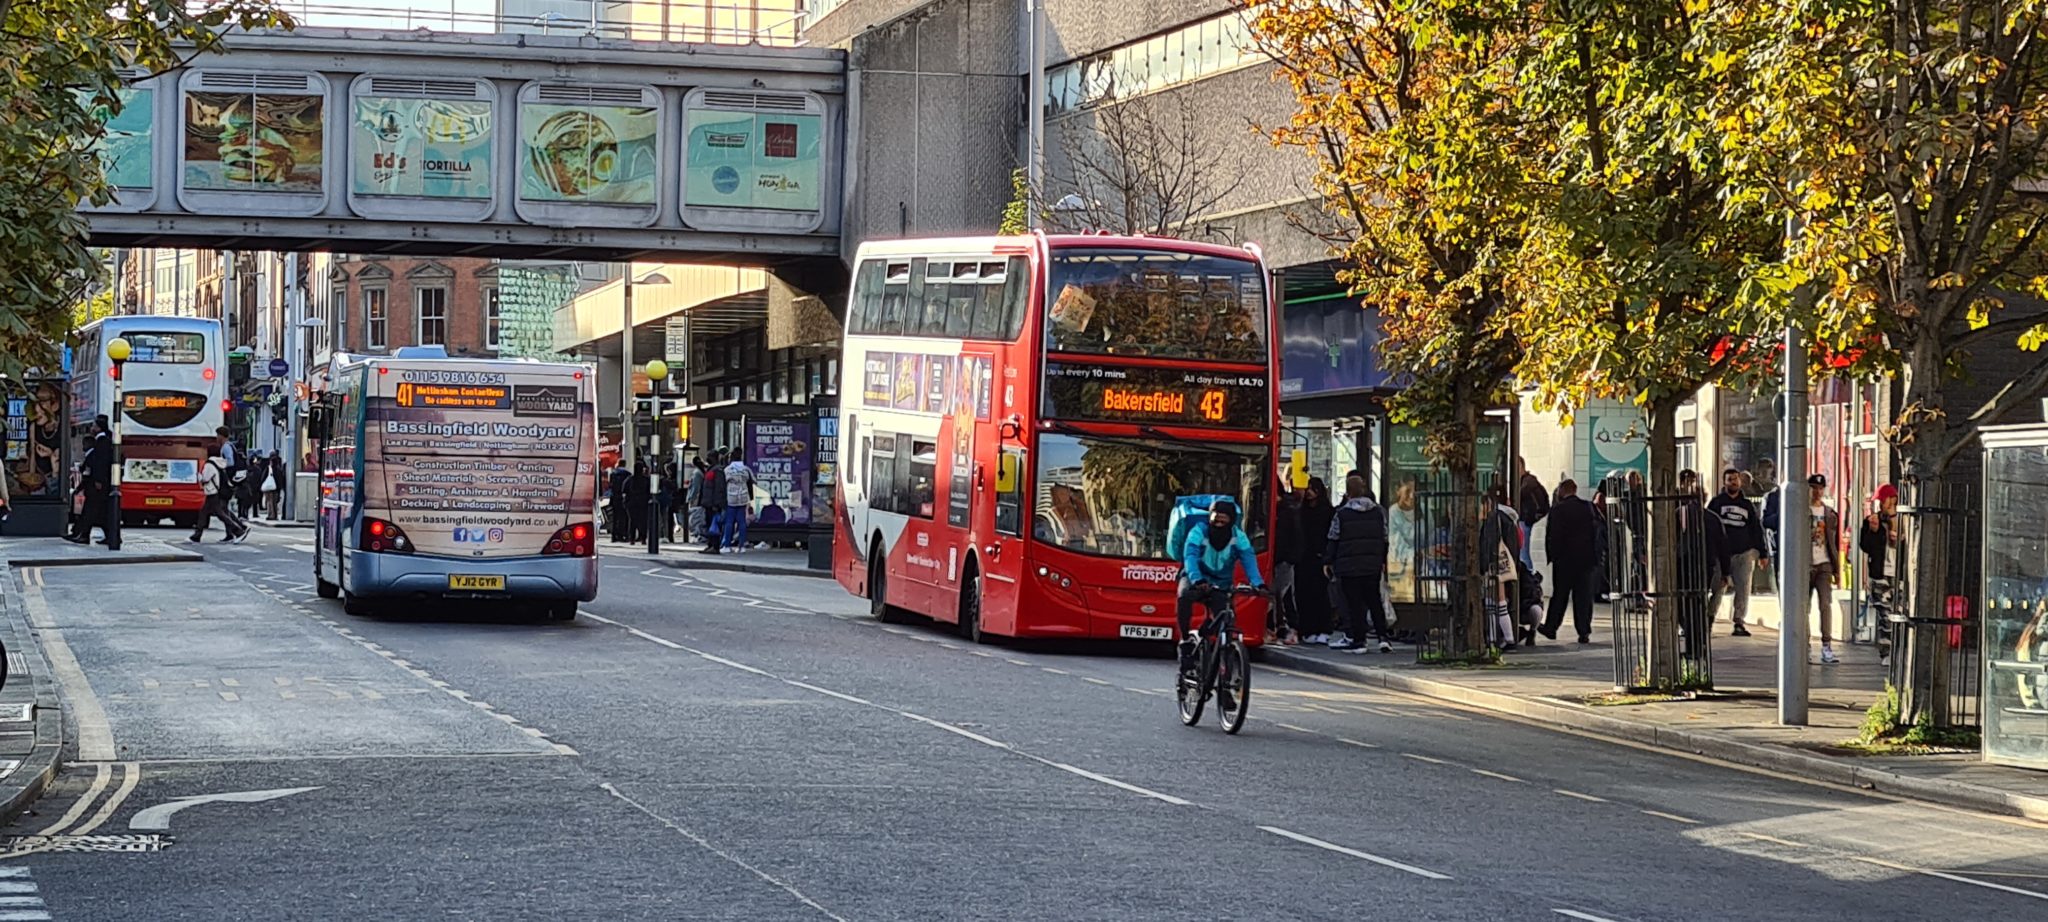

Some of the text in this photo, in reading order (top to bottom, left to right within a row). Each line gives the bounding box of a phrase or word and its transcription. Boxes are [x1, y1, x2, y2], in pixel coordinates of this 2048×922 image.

[374, 152, 406, 169] Ed's
[420, 160, 472, 172] TORTILLA
[405, 371, 505, 383] 0115 9816 654
[1066, 369, 1090, 378] every
[1092, 369, 1103, 377] 10
[1104, 370, 1126, 379] mins
[1184, 375, 1264, 387] All day travel £4.70
[397, 383, 413, 407] 41
[517, 401, 574, 411] WOODYARD
[1104, 389, 1224, 419] Bakersfield 43
[387, 421, 574, 440] Bassingfield Woodyard
[429, 441, 477, 449] Bassingfield
[414, 460, 554, 474] Construction Timber Fencing
[403, 473, 564, 486] Sheet Materials Screws & Fixings
[512, 489, 558, 497] Handrails
[401, 500, 565, 511] Decking & Landscaping Firewood
[399, 514, 559, 528] www.bassingfieldwoodyard.co.uk
[1121, 567, 1178, 583] Transpor
[455, 576, 497, 587] YJ12 GYR
[1124, 626, 1149, 637] YP63
